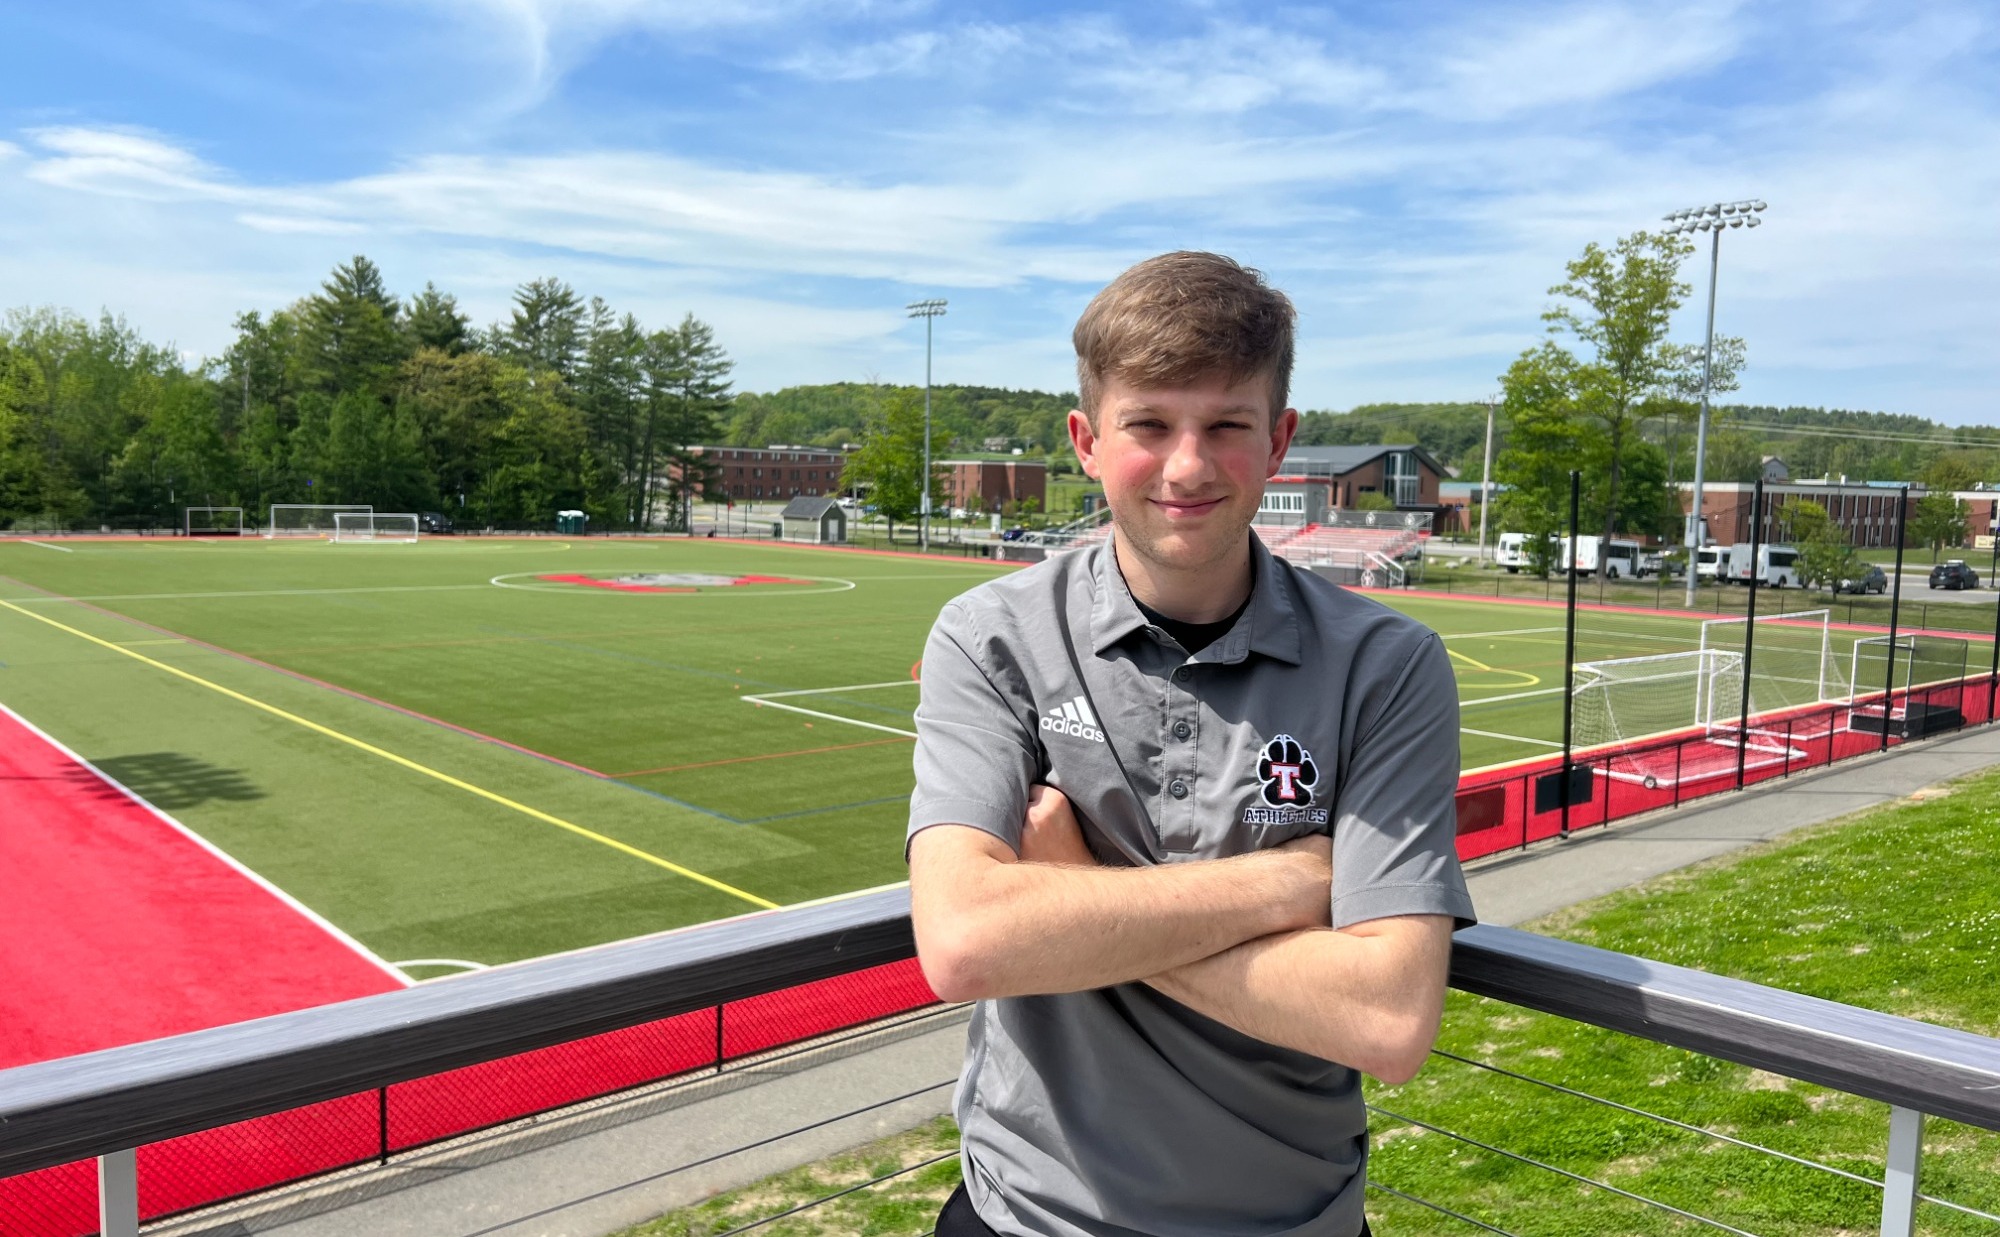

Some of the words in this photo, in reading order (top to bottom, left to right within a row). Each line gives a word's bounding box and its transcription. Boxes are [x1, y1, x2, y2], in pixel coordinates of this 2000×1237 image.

[1040, 716, 1105, 743] adidas
[1270, 762, 1300, 799] T
[1243, 808, 1327, 825] ATHLETICS
